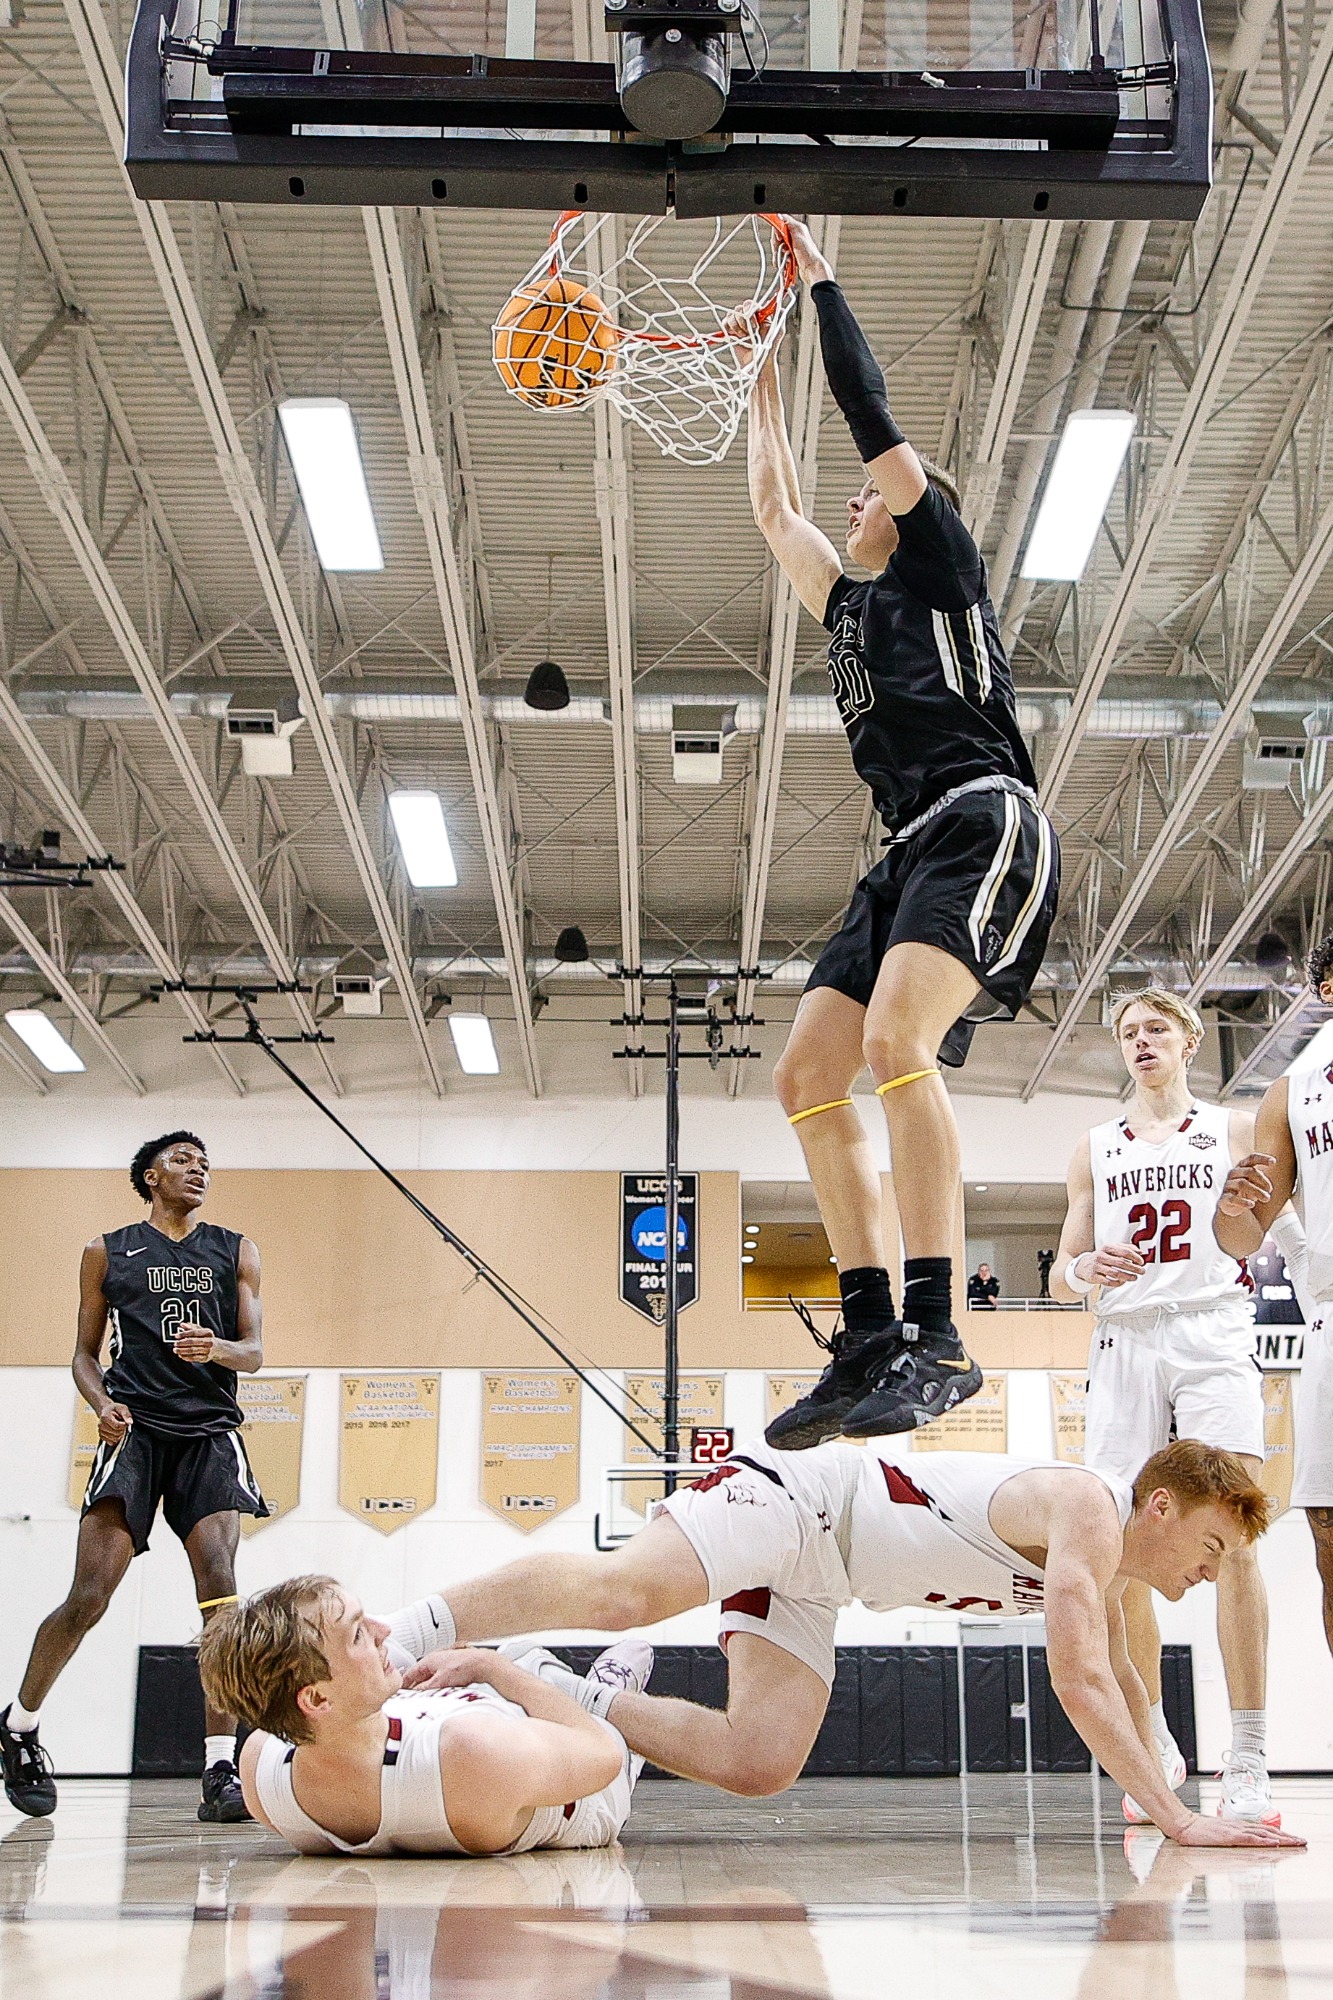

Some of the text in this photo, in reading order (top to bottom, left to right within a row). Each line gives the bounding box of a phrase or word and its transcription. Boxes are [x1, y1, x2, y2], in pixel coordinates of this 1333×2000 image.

[1305, 1119, 1333, 1159] MA
[1106, 1164, 1213, 1203] MAVERICKS
[637, 1231, 686, 1247] NCA
[1128, 1199, 1191, 1263] 22
[147, 1266, 213, 1294] UCCS
[625, 1262, 693, 1273] FINAL FUR
[639, 1275, 668, 1290] 201
[160, 1298, 201, 1343] 21
[694, 1433, 730, 1463] 22
[359, 1496, 417, 1513] UCCS
[501, 1495, 558, 1511] UCCS
